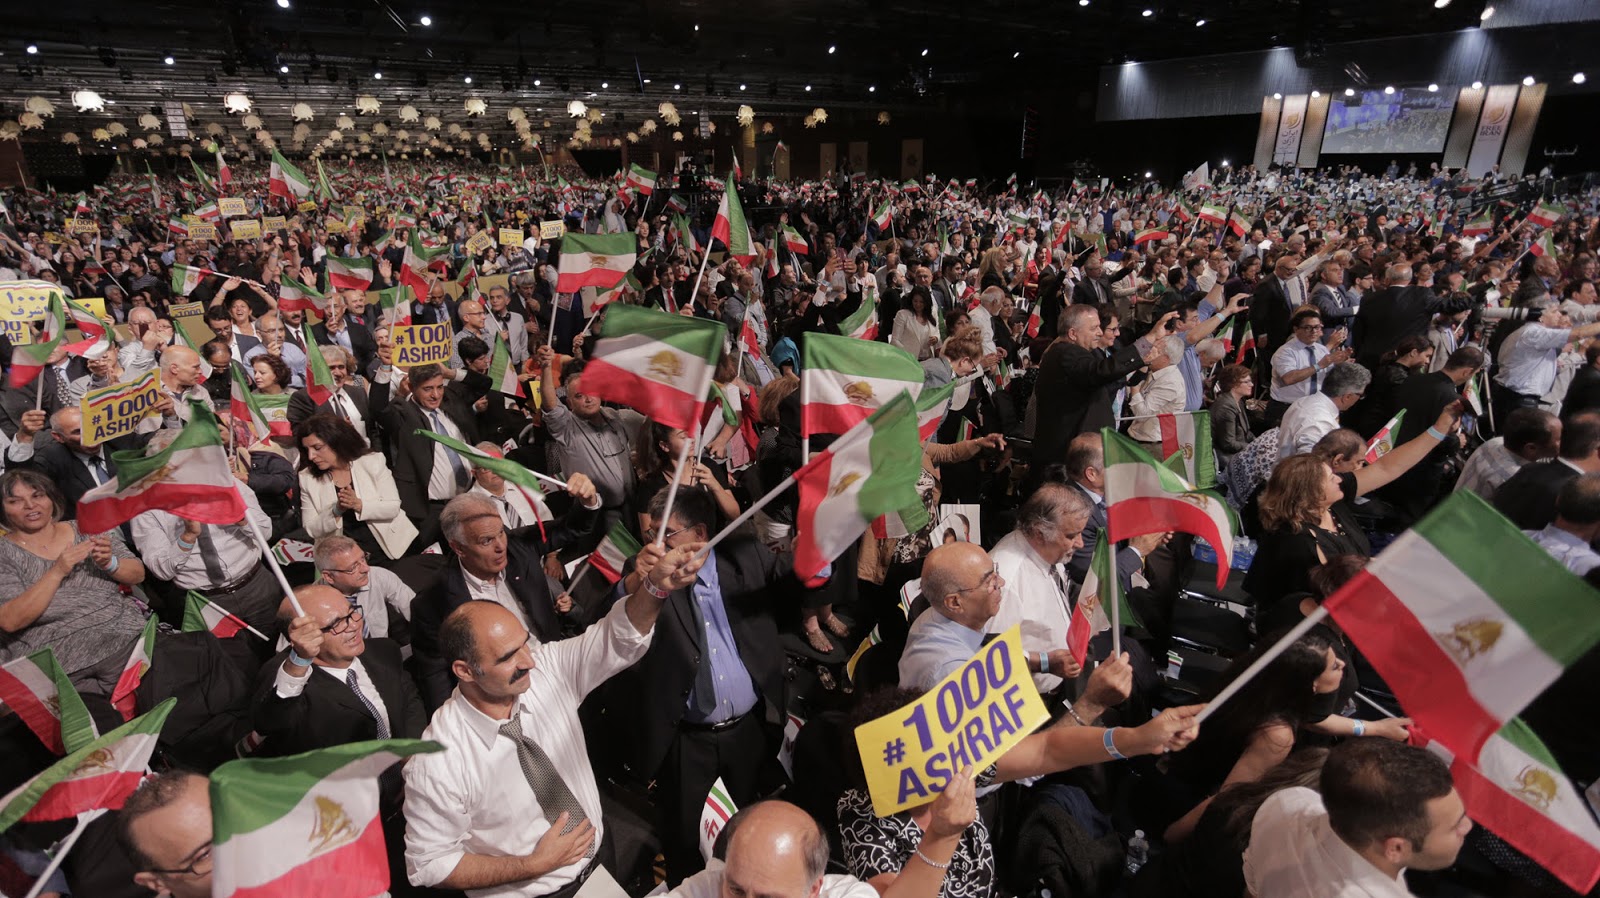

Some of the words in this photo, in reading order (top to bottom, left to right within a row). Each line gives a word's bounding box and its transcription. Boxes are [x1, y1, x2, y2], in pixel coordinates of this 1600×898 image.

[395, 321, 451, 345] #1000
[92, 388, 158, 425] #1000
[94, 411, 147, 441] ASHR
[883, 640, 1012, 767] #1000
[897, 684, 1025, 804] ASHRAF
